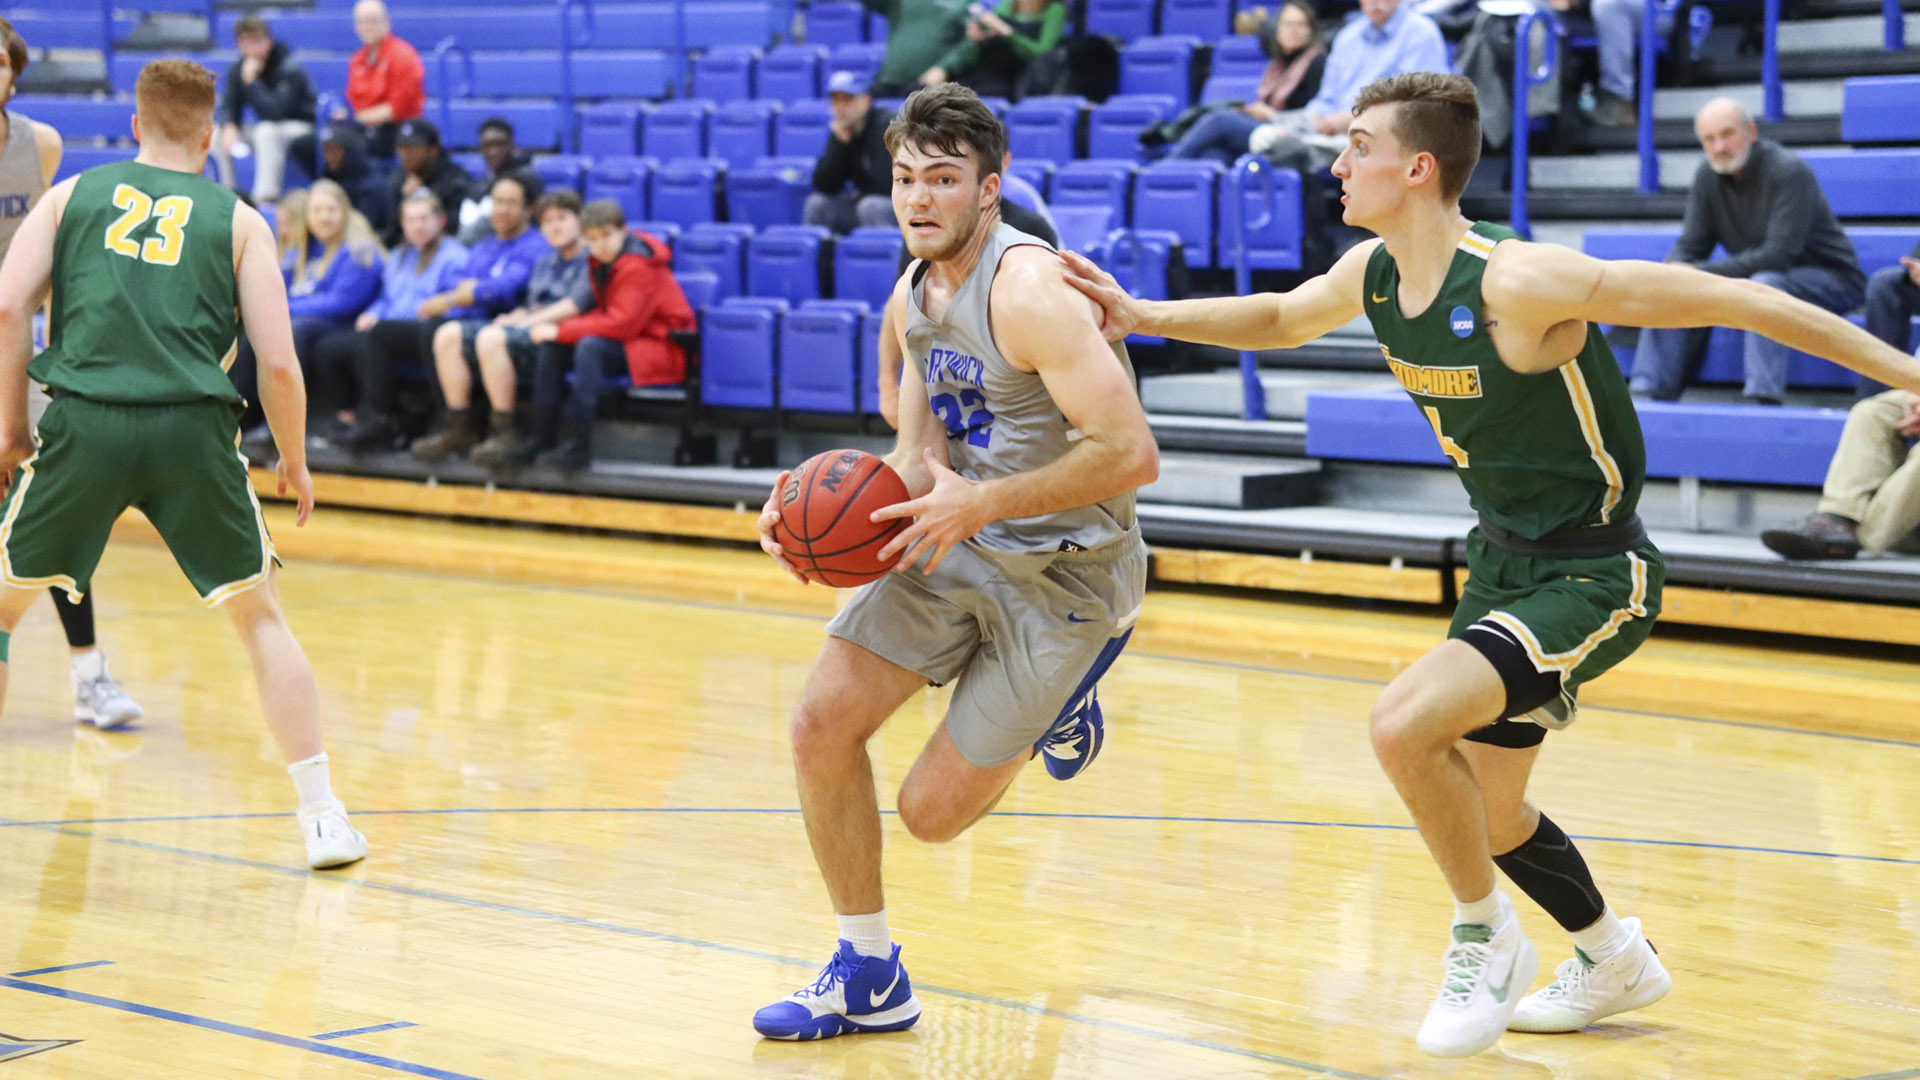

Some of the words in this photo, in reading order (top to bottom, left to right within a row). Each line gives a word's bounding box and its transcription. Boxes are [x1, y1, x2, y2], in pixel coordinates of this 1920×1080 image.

[104, 183, 194, 267] 23
[925, 348, 987, 391] RTWICK
[1380, 343, 1483, 398] IDMORE
[931, 389, 995, 449] 32
[1423, 406, 1470, 468] 4
